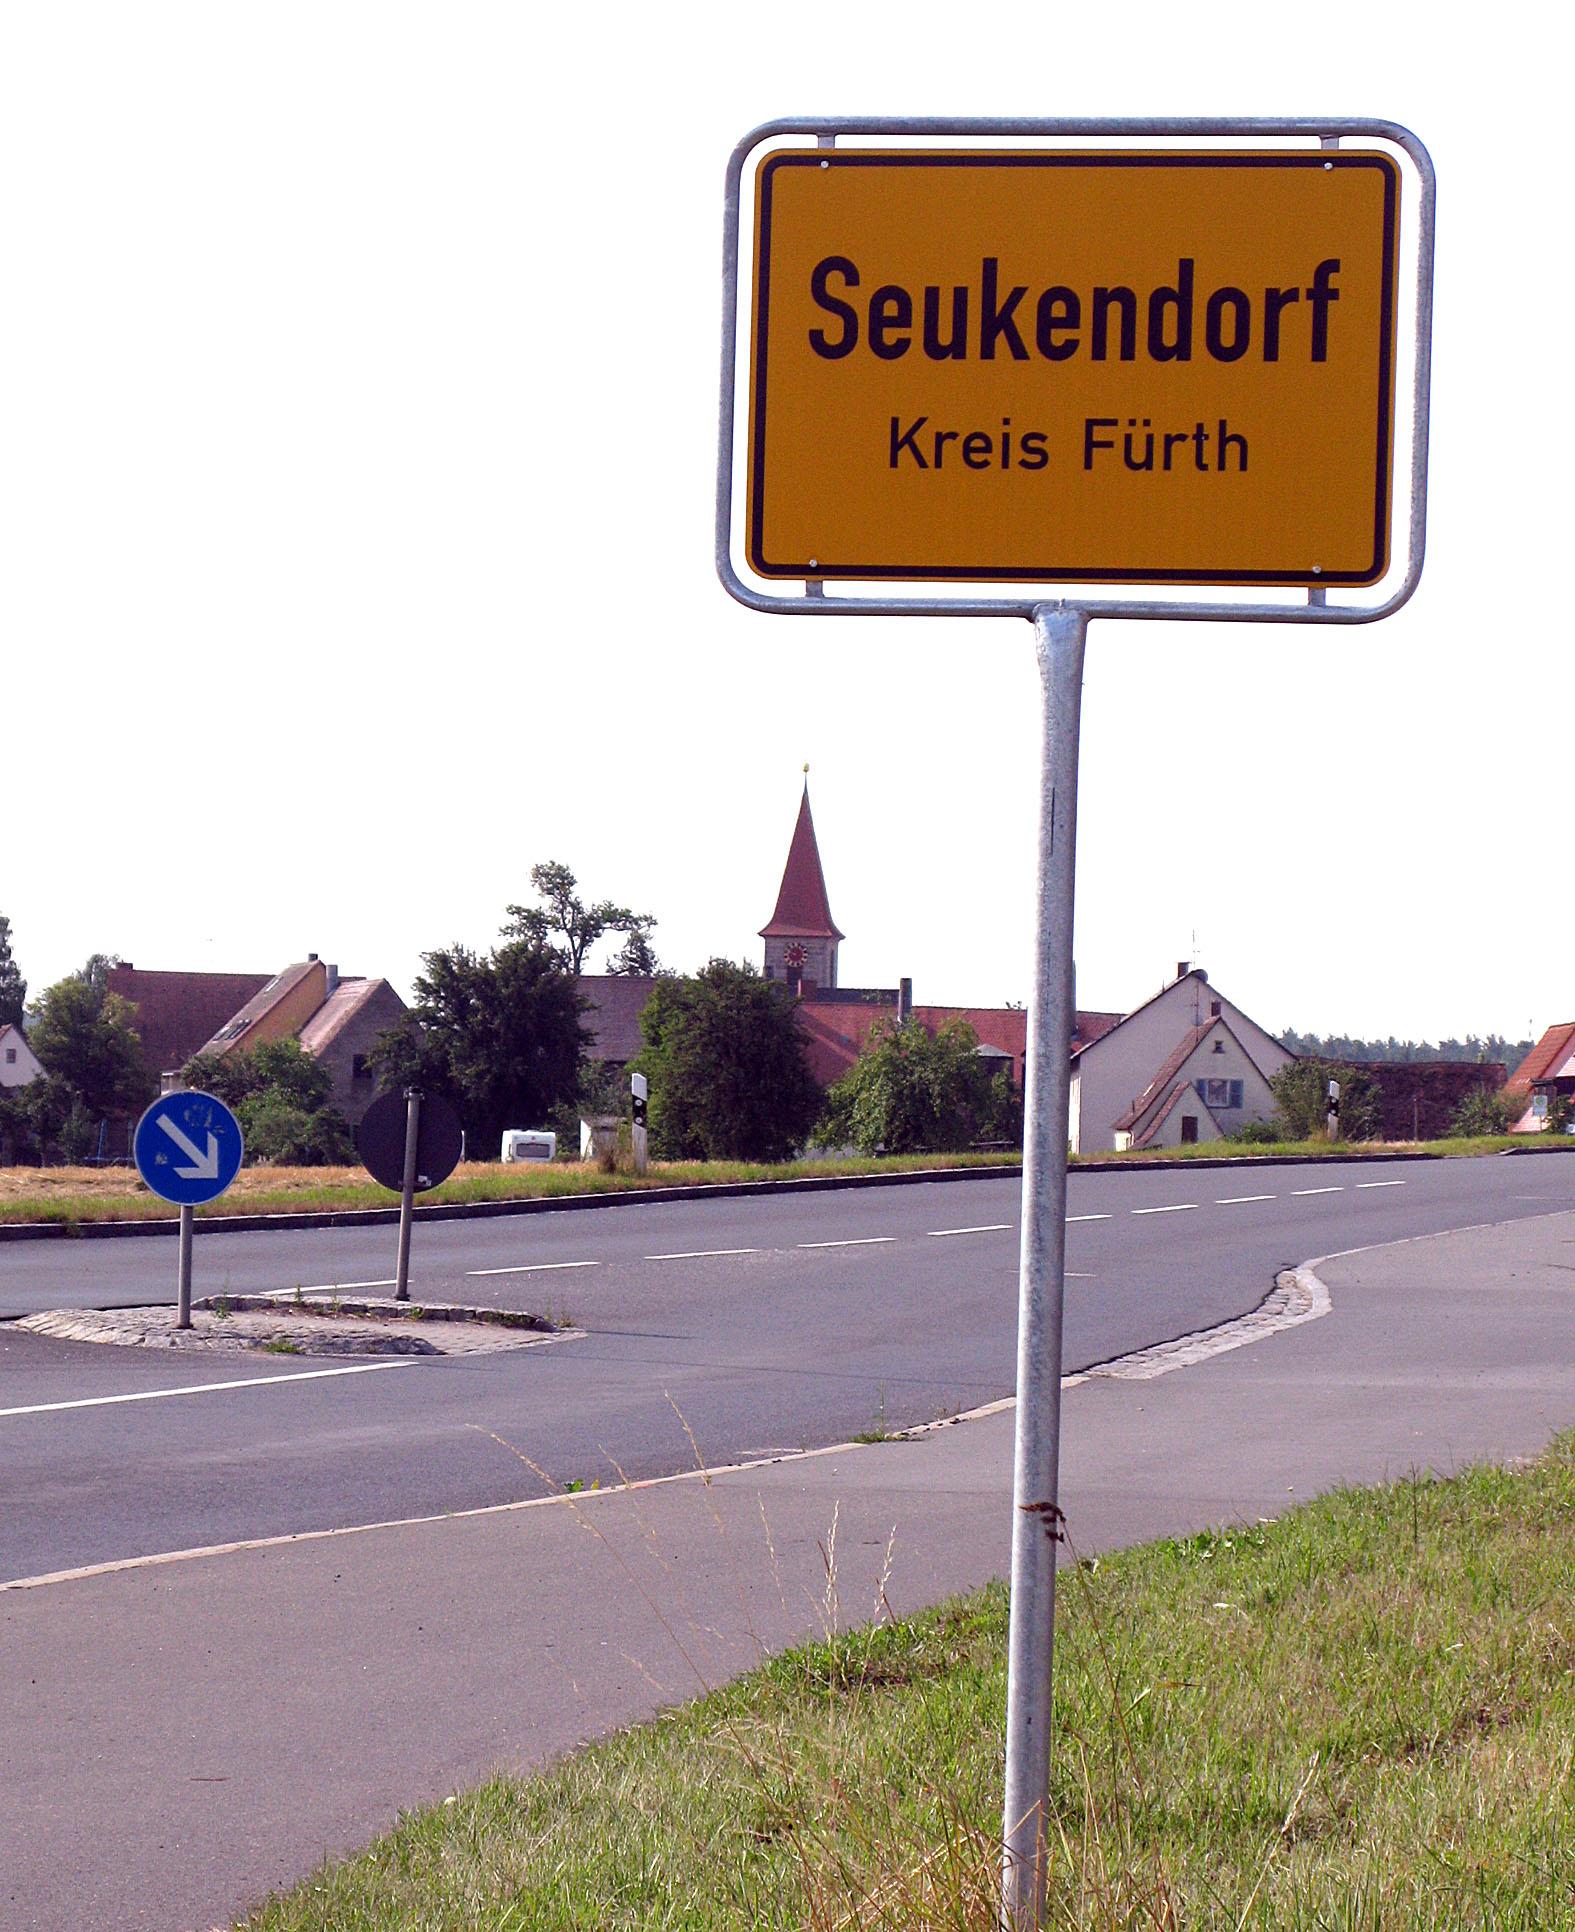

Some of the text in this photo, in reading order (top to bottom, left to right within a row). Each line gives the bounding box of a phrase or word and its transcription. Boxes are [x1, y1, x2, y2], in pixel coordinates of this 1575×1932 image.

[808, 255, 1341, 363] Seukendorf
[889, 416, 1249, 472] Kreis Fürth
